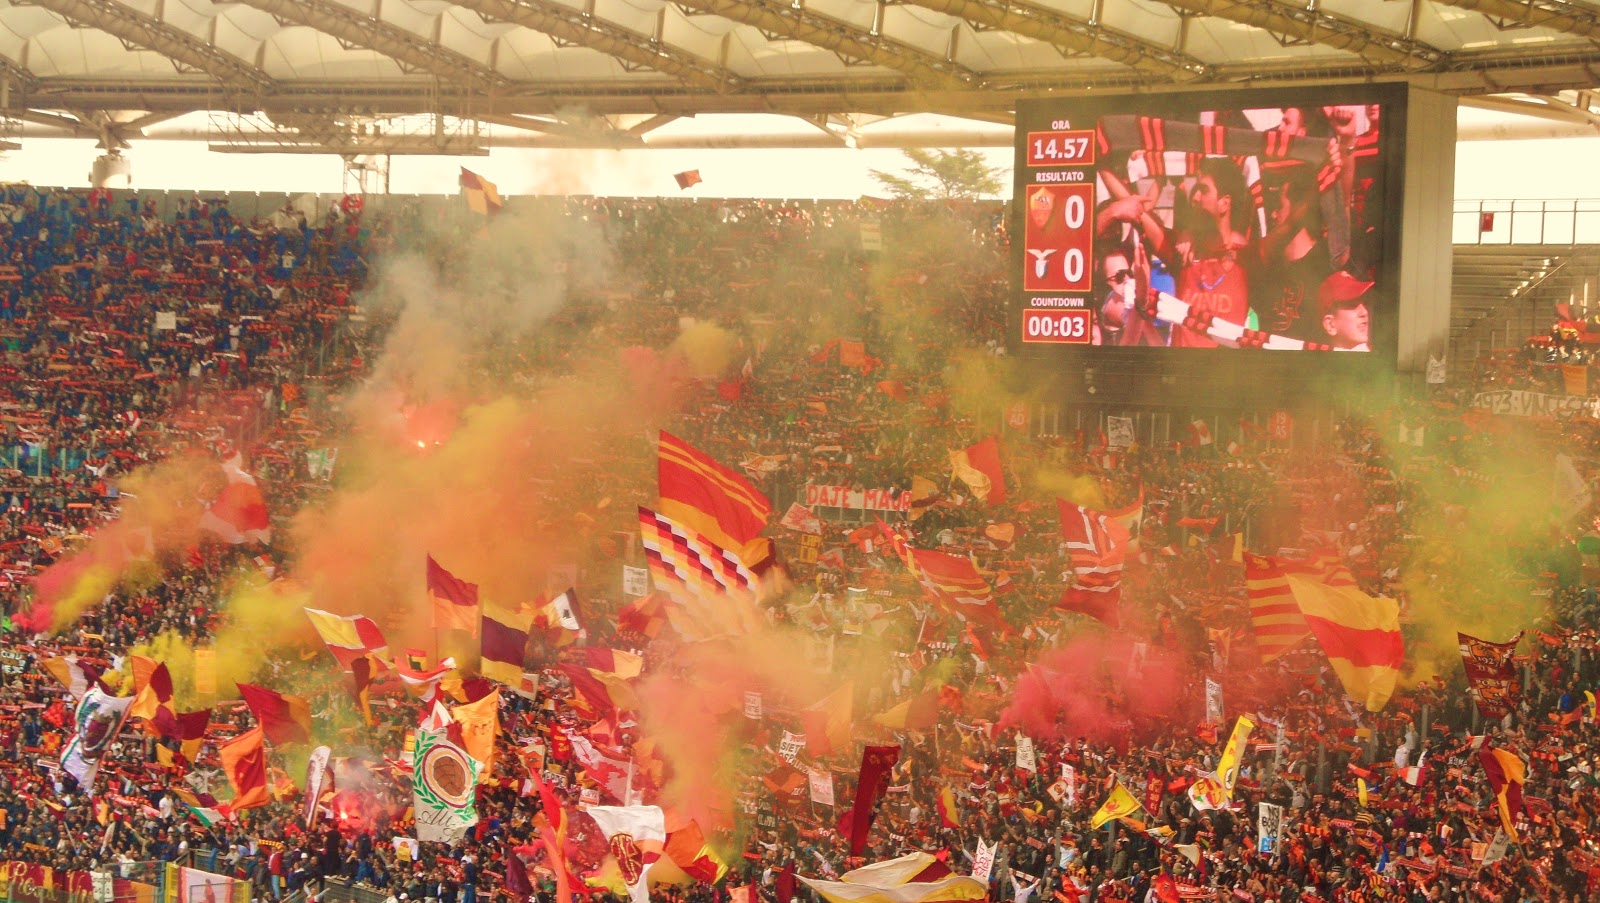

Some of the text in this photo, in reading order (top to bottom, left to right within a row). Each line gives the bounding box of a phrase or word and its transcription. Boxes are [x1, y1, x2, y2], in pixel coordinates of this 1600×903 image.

[1051, 120, 1070, 130] ORA
[1034, 138, 1088, 159] 14.57
[1036, 172, 1084, 182] RISULTATO
[1064, 195, 1085, 229] 0
[1063, 248, 1084, 282] 0
[1031, 298, 1084, 307] COUNTDOWN
[1028, 316, 1084, 337] 00:03
[806, 484, 850, 508] DAJE
